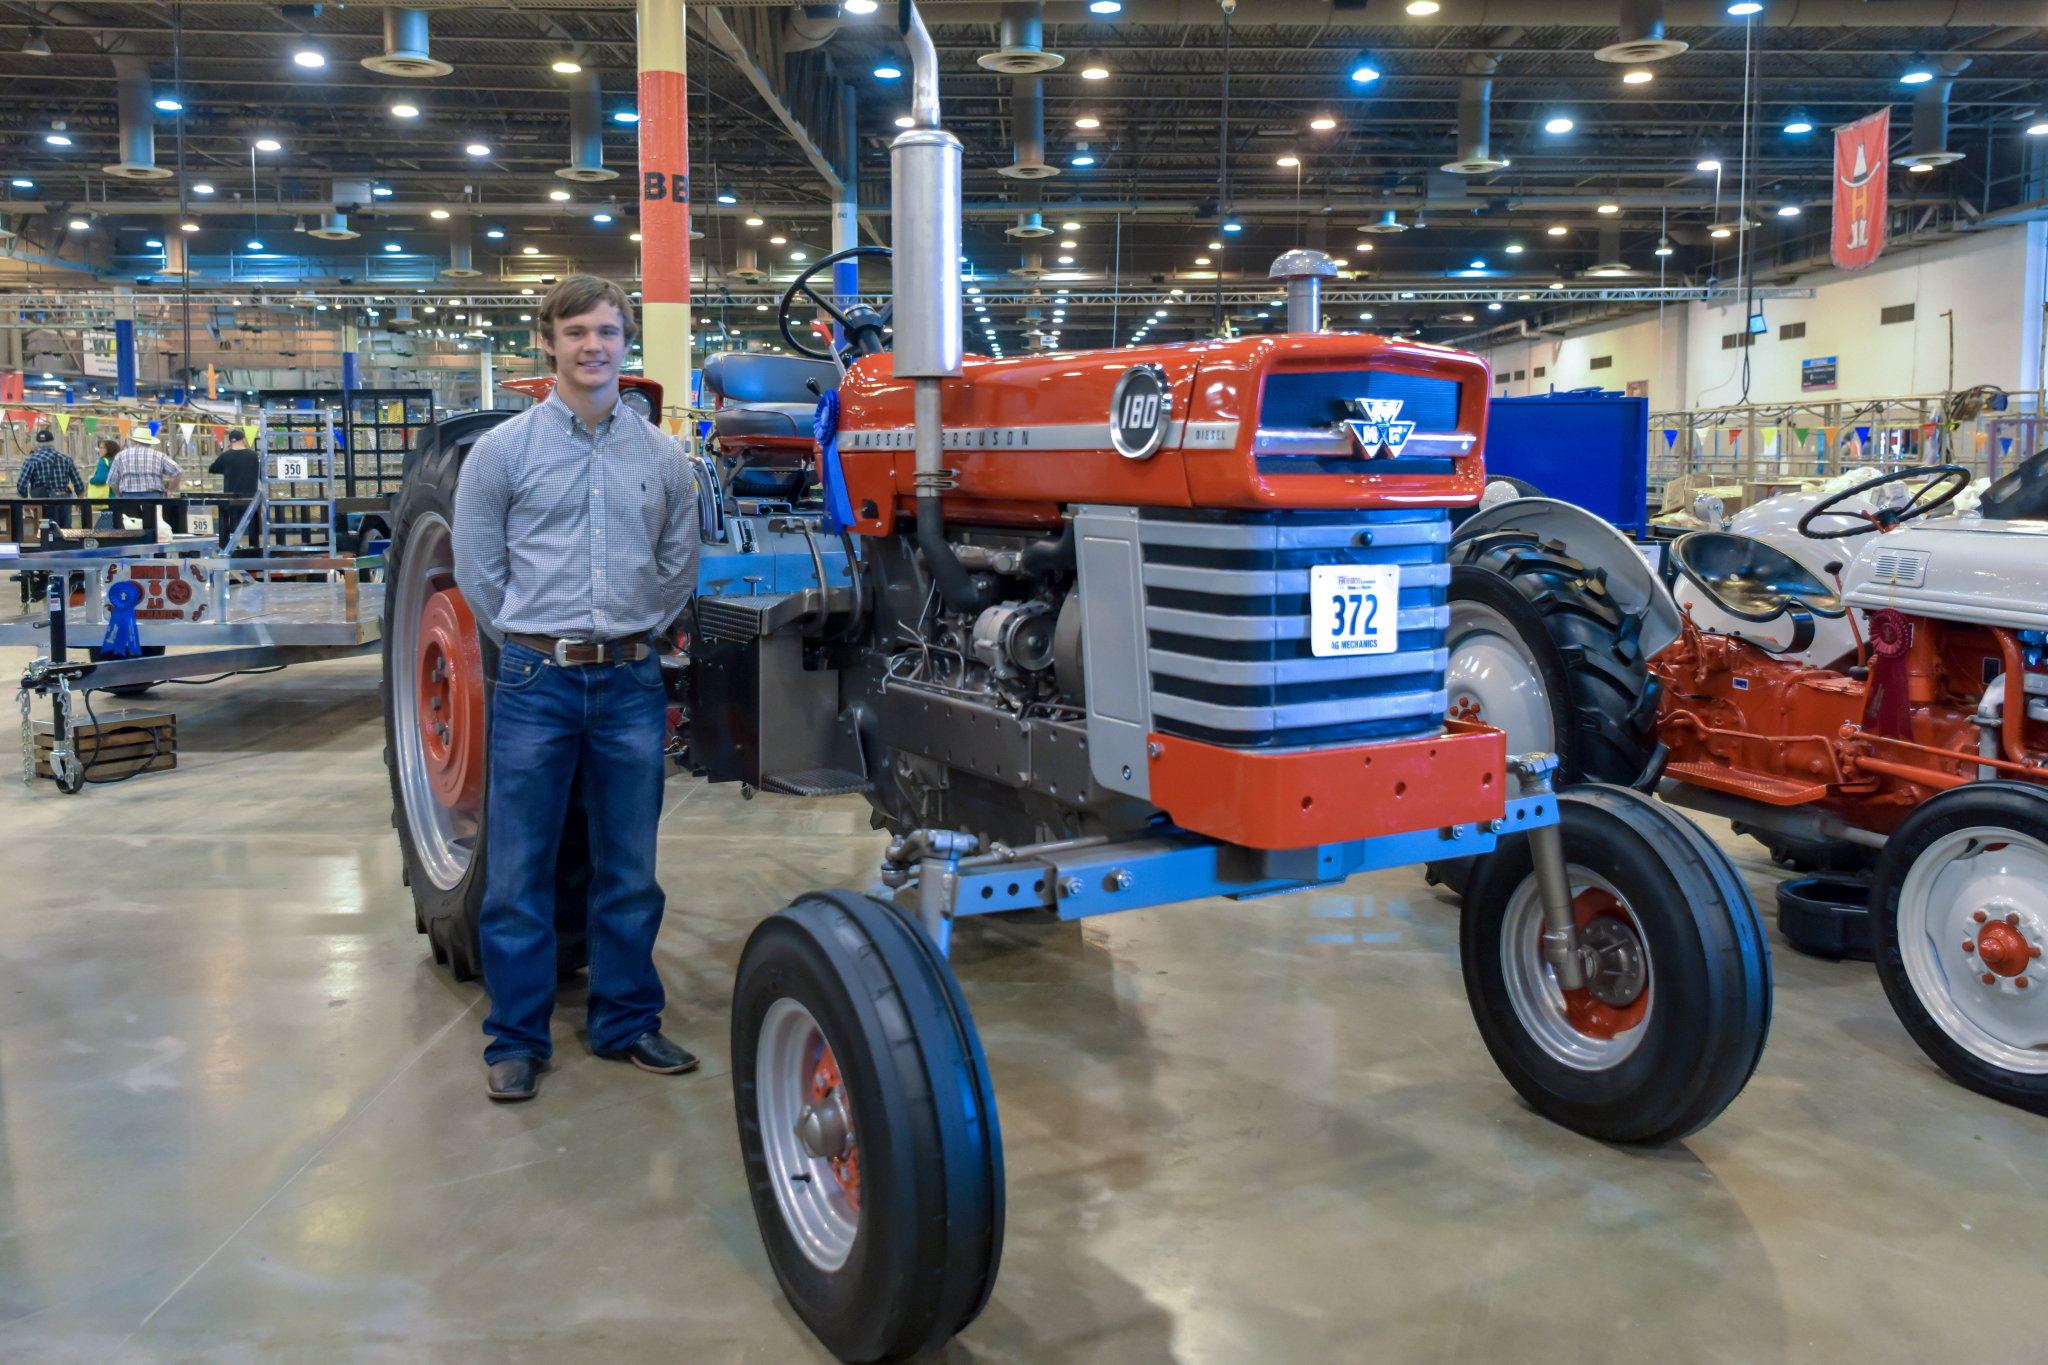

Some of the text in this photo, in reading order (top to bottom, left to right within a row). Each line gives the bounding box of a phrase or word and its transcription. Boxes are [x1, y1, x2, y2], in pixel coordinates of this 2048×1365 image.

[1121, 394, 1159, 429] 180
[854, 431, 1029, 447] MASSEY ERGUSON
[1195, 430, 1226, 441] DIESEL
[284, 464, 301, 475] 350
[193, 521, 208, 530] 505
[1331, 594, 1378, 637] 372
[1331, 639, 1378, 650] AG MECHANICS
